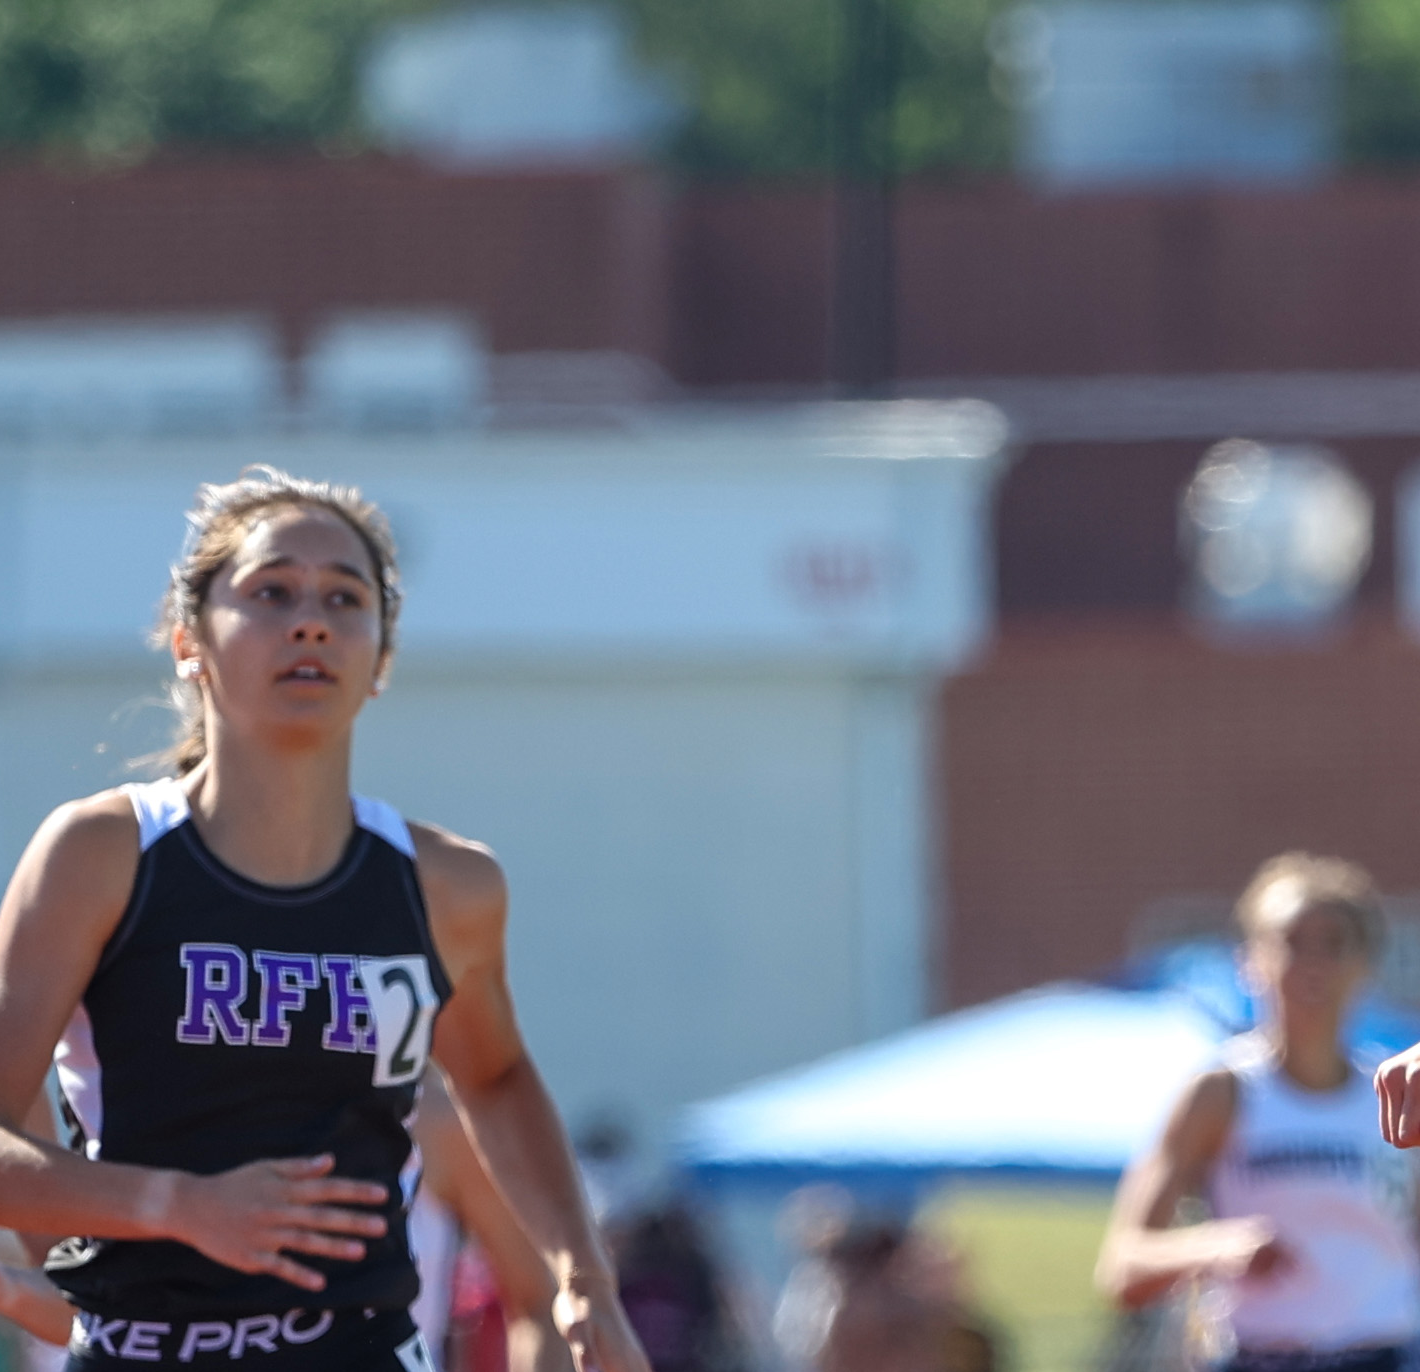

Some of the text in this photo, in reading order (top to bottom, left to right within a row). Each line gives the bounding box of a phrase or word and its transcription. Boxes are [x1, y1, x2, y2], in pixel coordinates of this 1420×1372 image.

[381, 967, 421, 1077] 2
[78, 1305, 335, 1363] KE PRO
